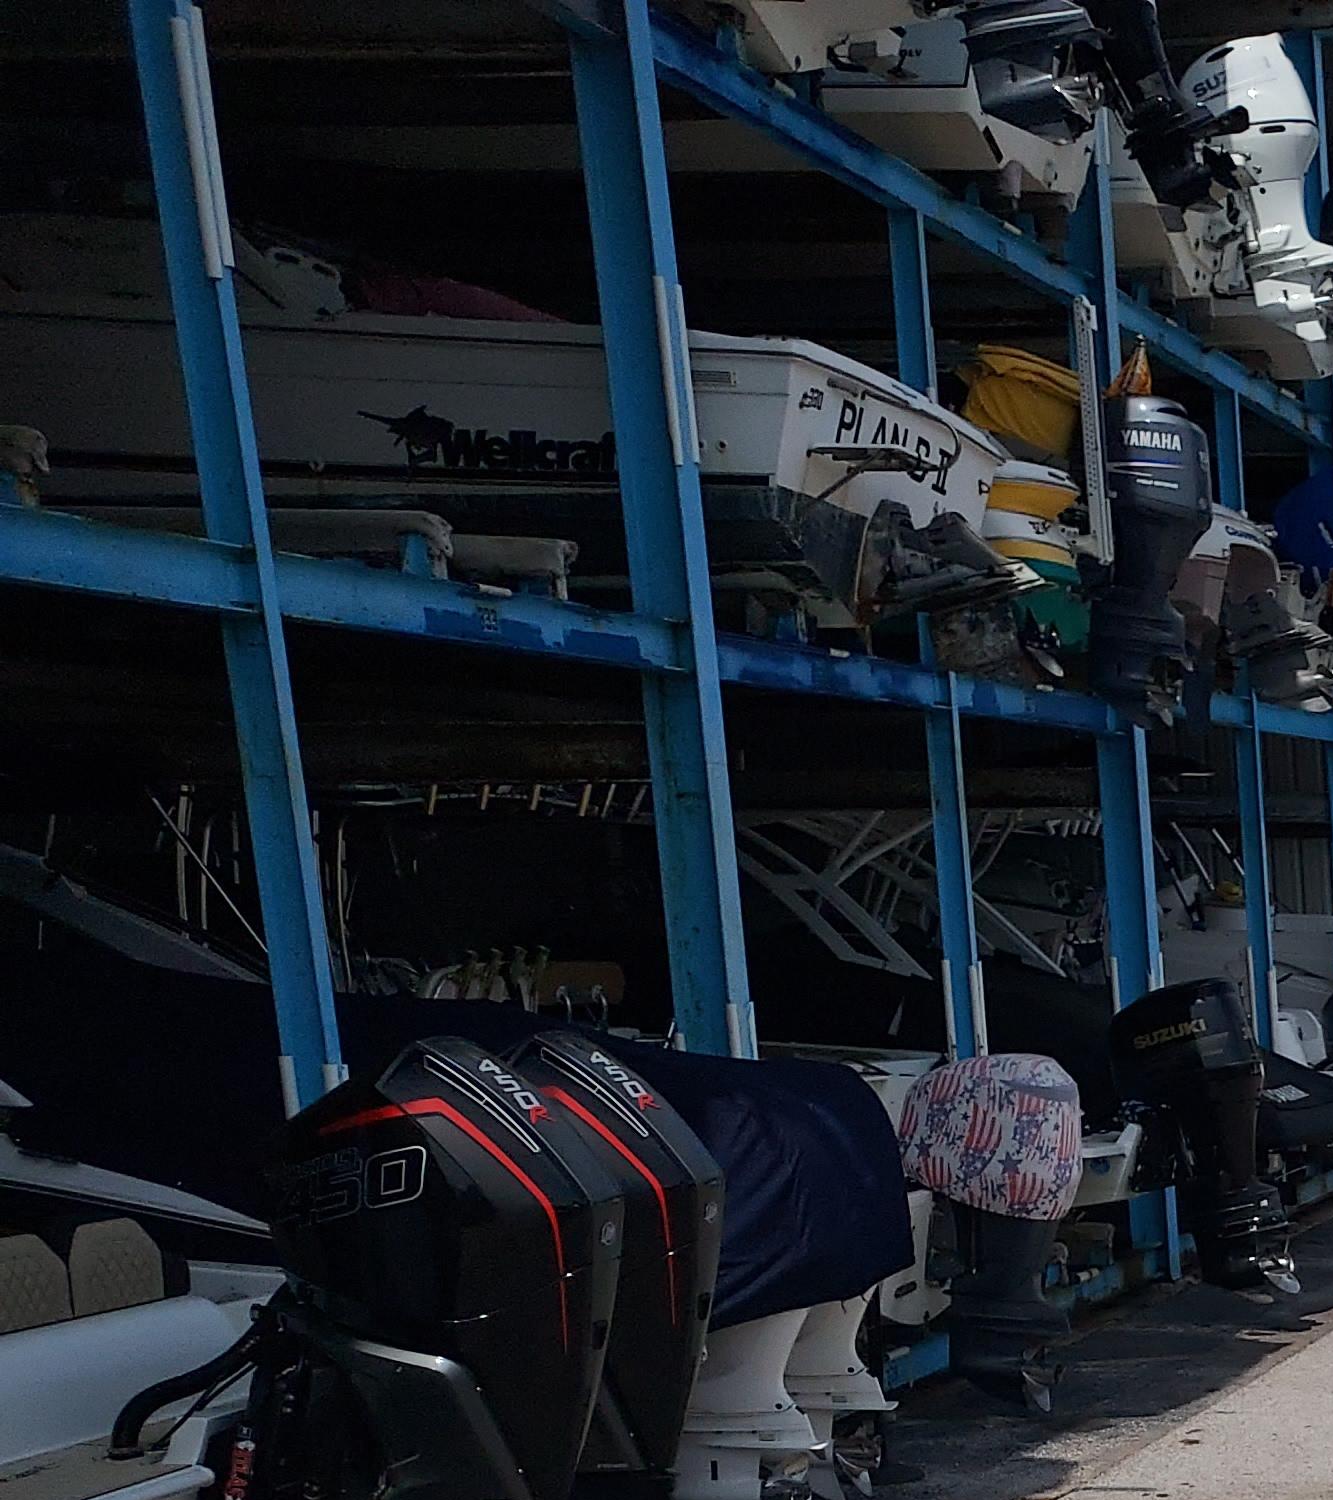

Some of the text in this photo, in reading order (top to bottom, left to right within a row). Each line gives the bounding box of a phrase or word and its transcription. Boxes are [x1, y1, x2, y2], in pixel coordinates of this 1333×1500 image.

[450, 428, 616, 469] Wellcraf
[1121, 429, 1182, 451] YAMAHA
[1133, 1018, 1208, 1049] SUZUKI
